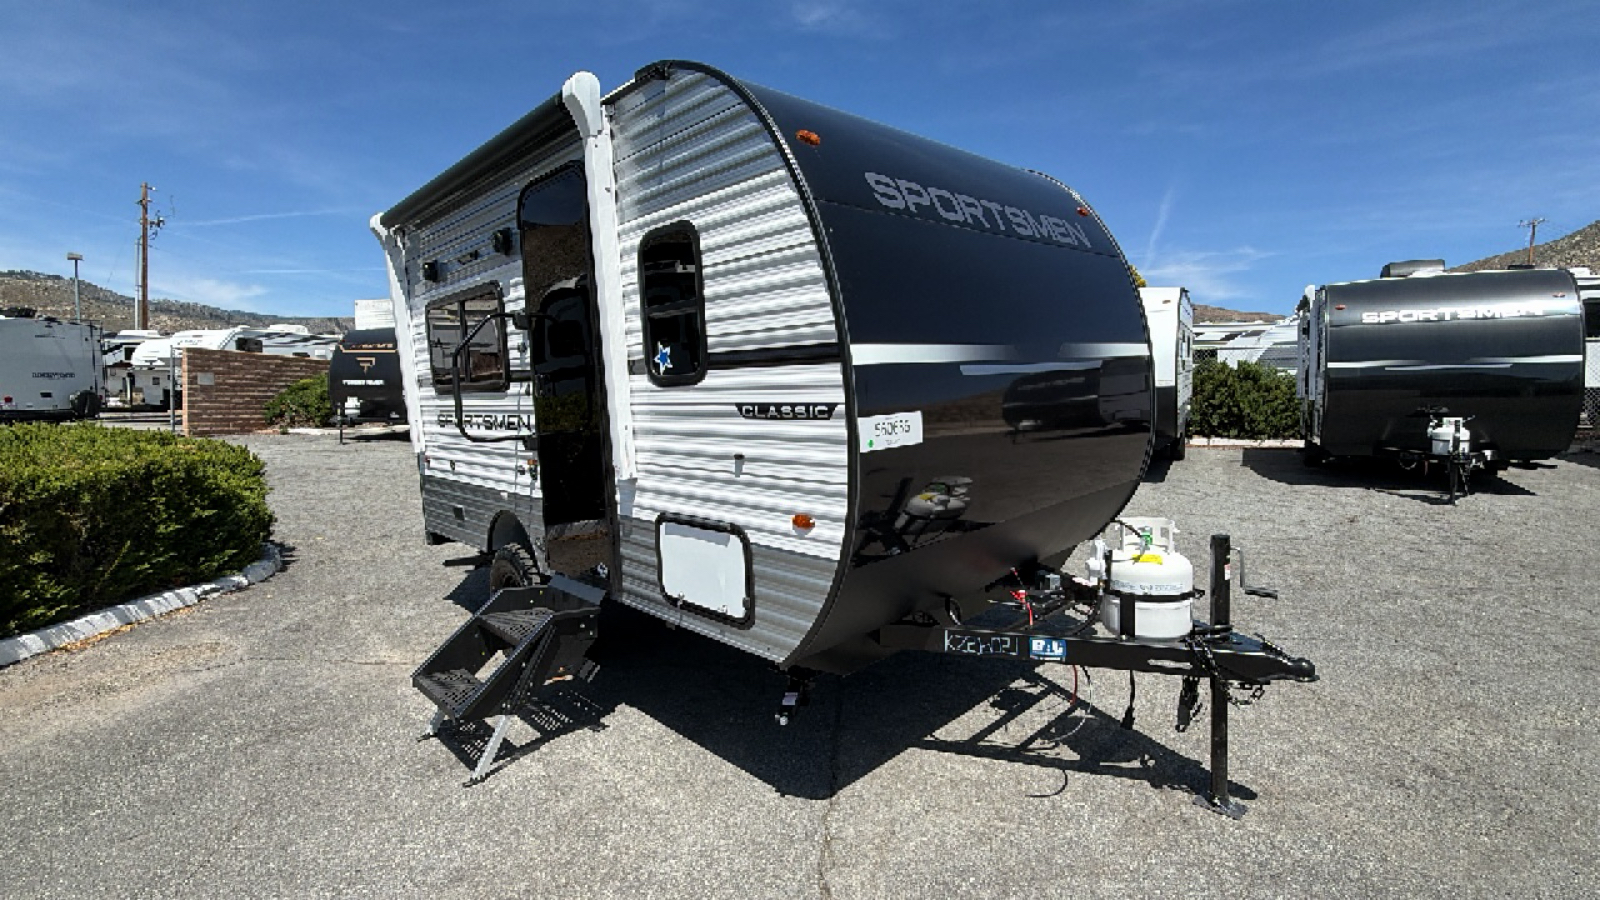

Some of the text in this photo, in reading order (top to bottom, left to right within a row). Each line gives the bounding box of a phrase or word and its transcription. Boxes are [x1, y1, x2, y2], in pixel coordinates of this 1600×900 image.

[864, 171, 1092, 248] SPORTSMEN
[741, 405, 829, 418] CLASSIC
[437, 414, 532, 431] SPRTSMEN
